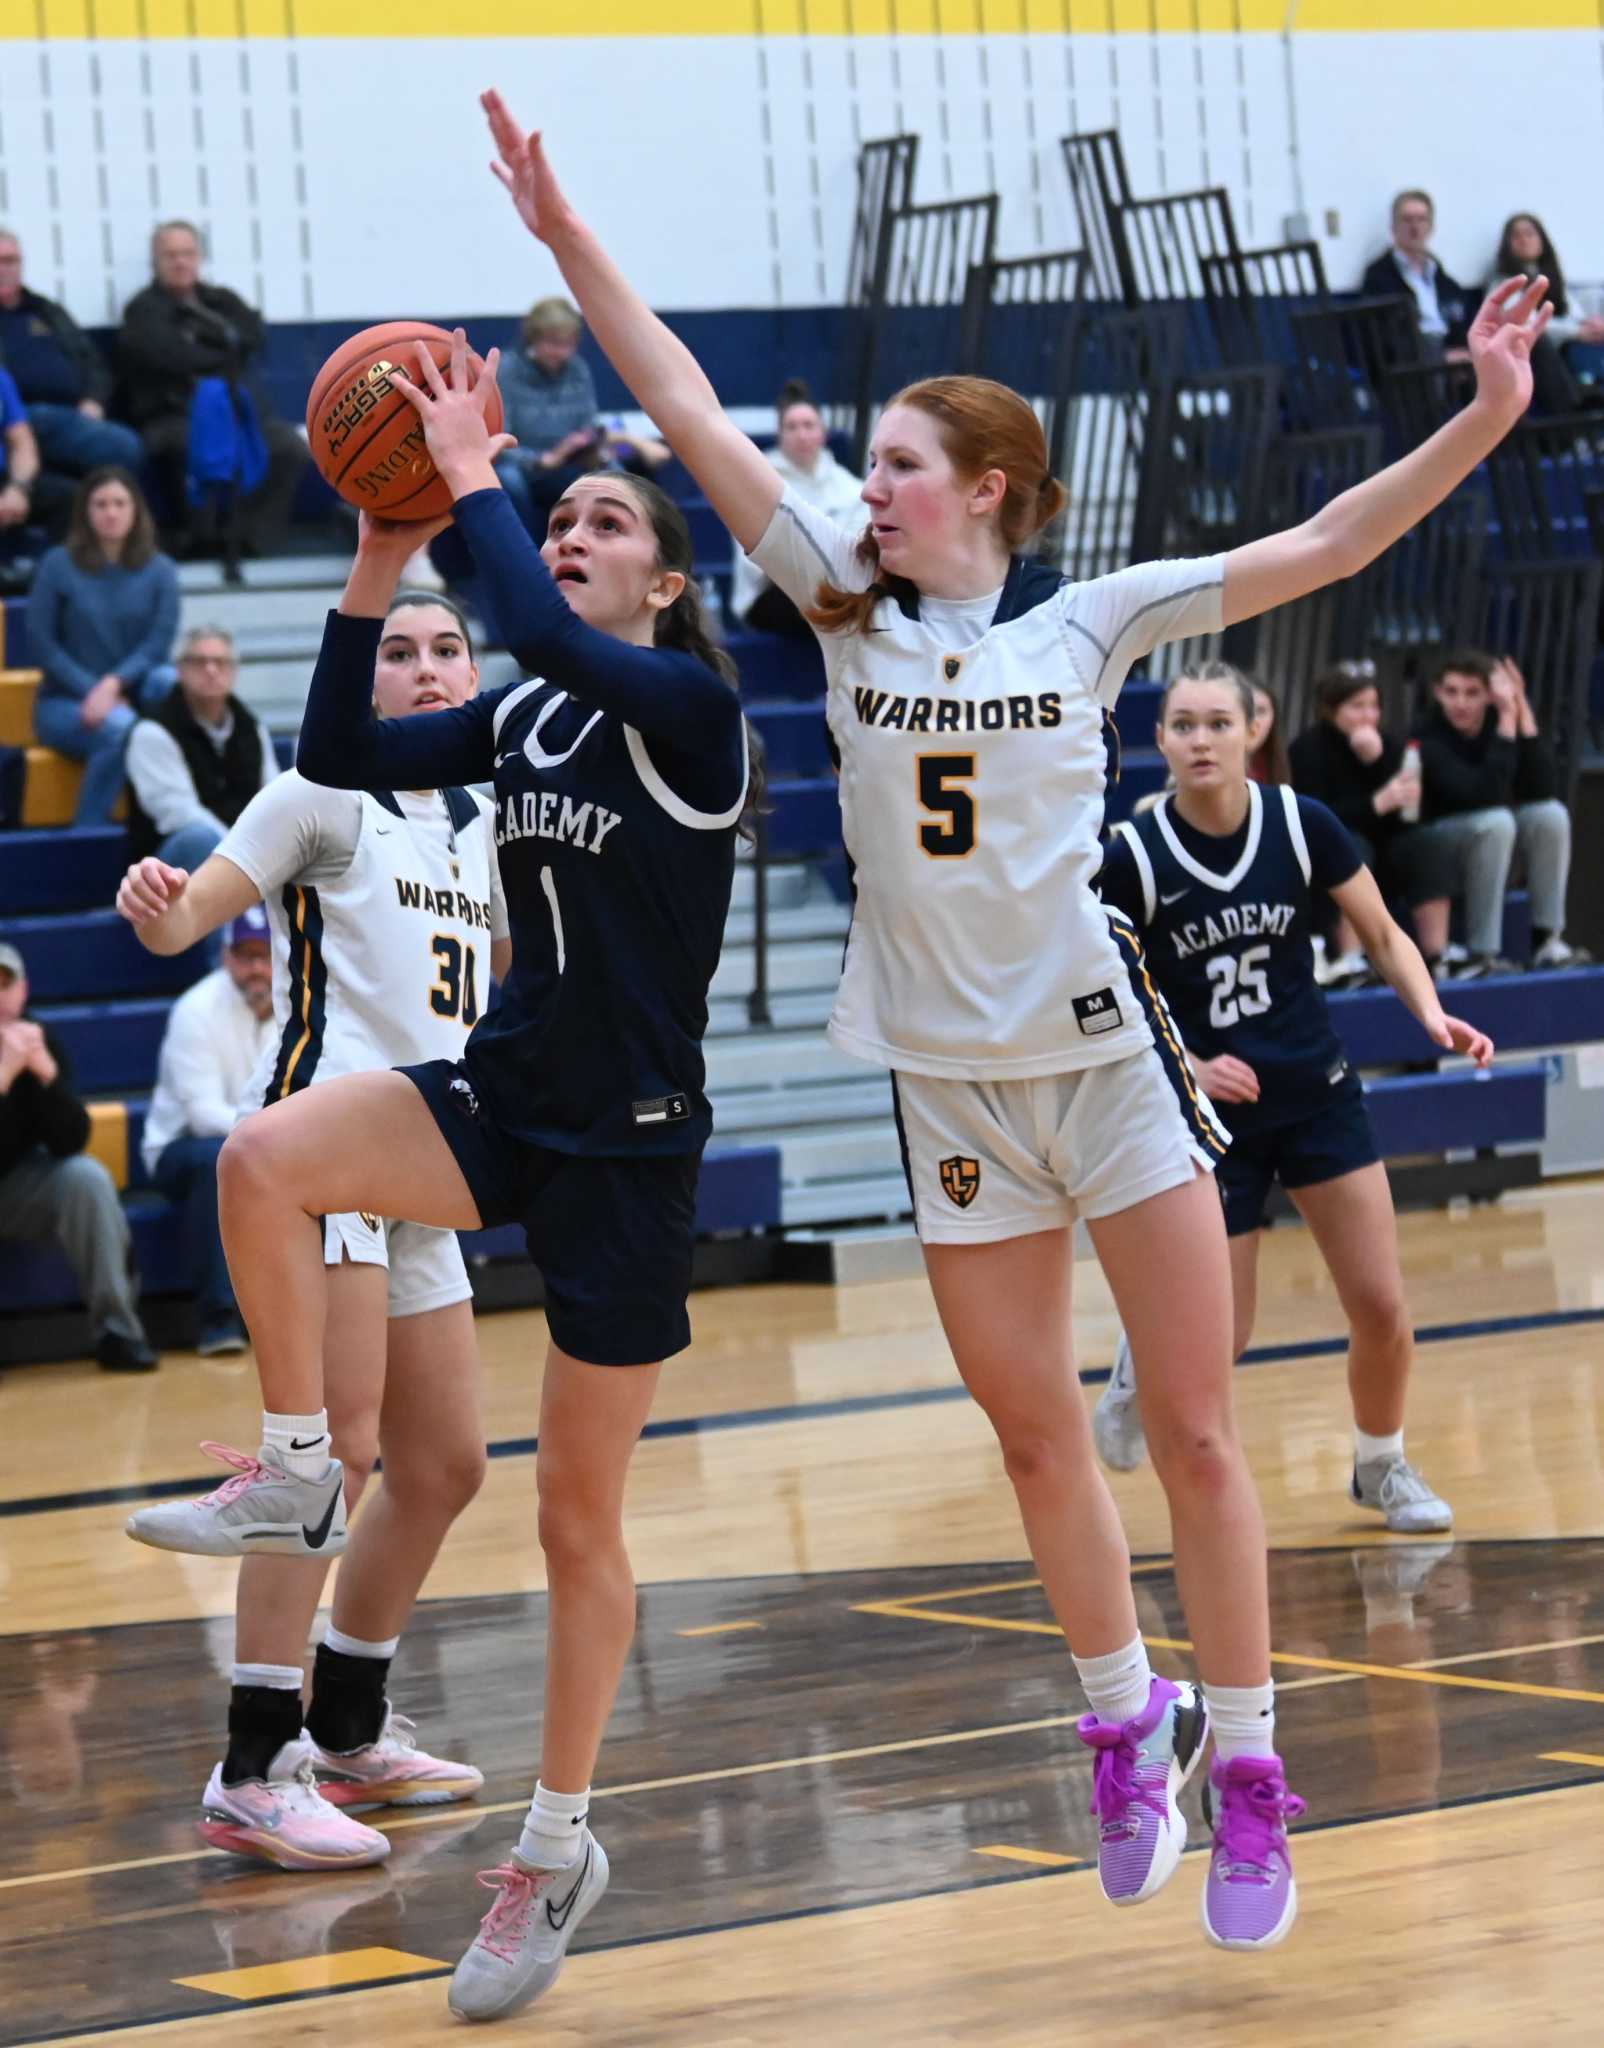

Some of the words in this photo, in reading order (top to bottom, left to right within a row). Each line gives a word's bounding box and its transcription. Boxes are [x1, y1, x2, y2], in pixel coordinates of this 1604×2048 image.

[328, 365, 411, 457] LEGACY
[354, 419, 425, 497] ALDING
[854, 685, 1063, 733] WARRIORS
[493, 791, 622, 855] CADEMY
[914, 751, 978, 860] 5
[395, 877, 491, 930] WARRORS
[539, 864, 567, 977] 1
[1169, 902, 1297, 960] ACADEMY
[1086, 996, 1105, 1012] M
[1205, 943, 1273, 1030] 25
[673, 1100, 683, 1113] S
